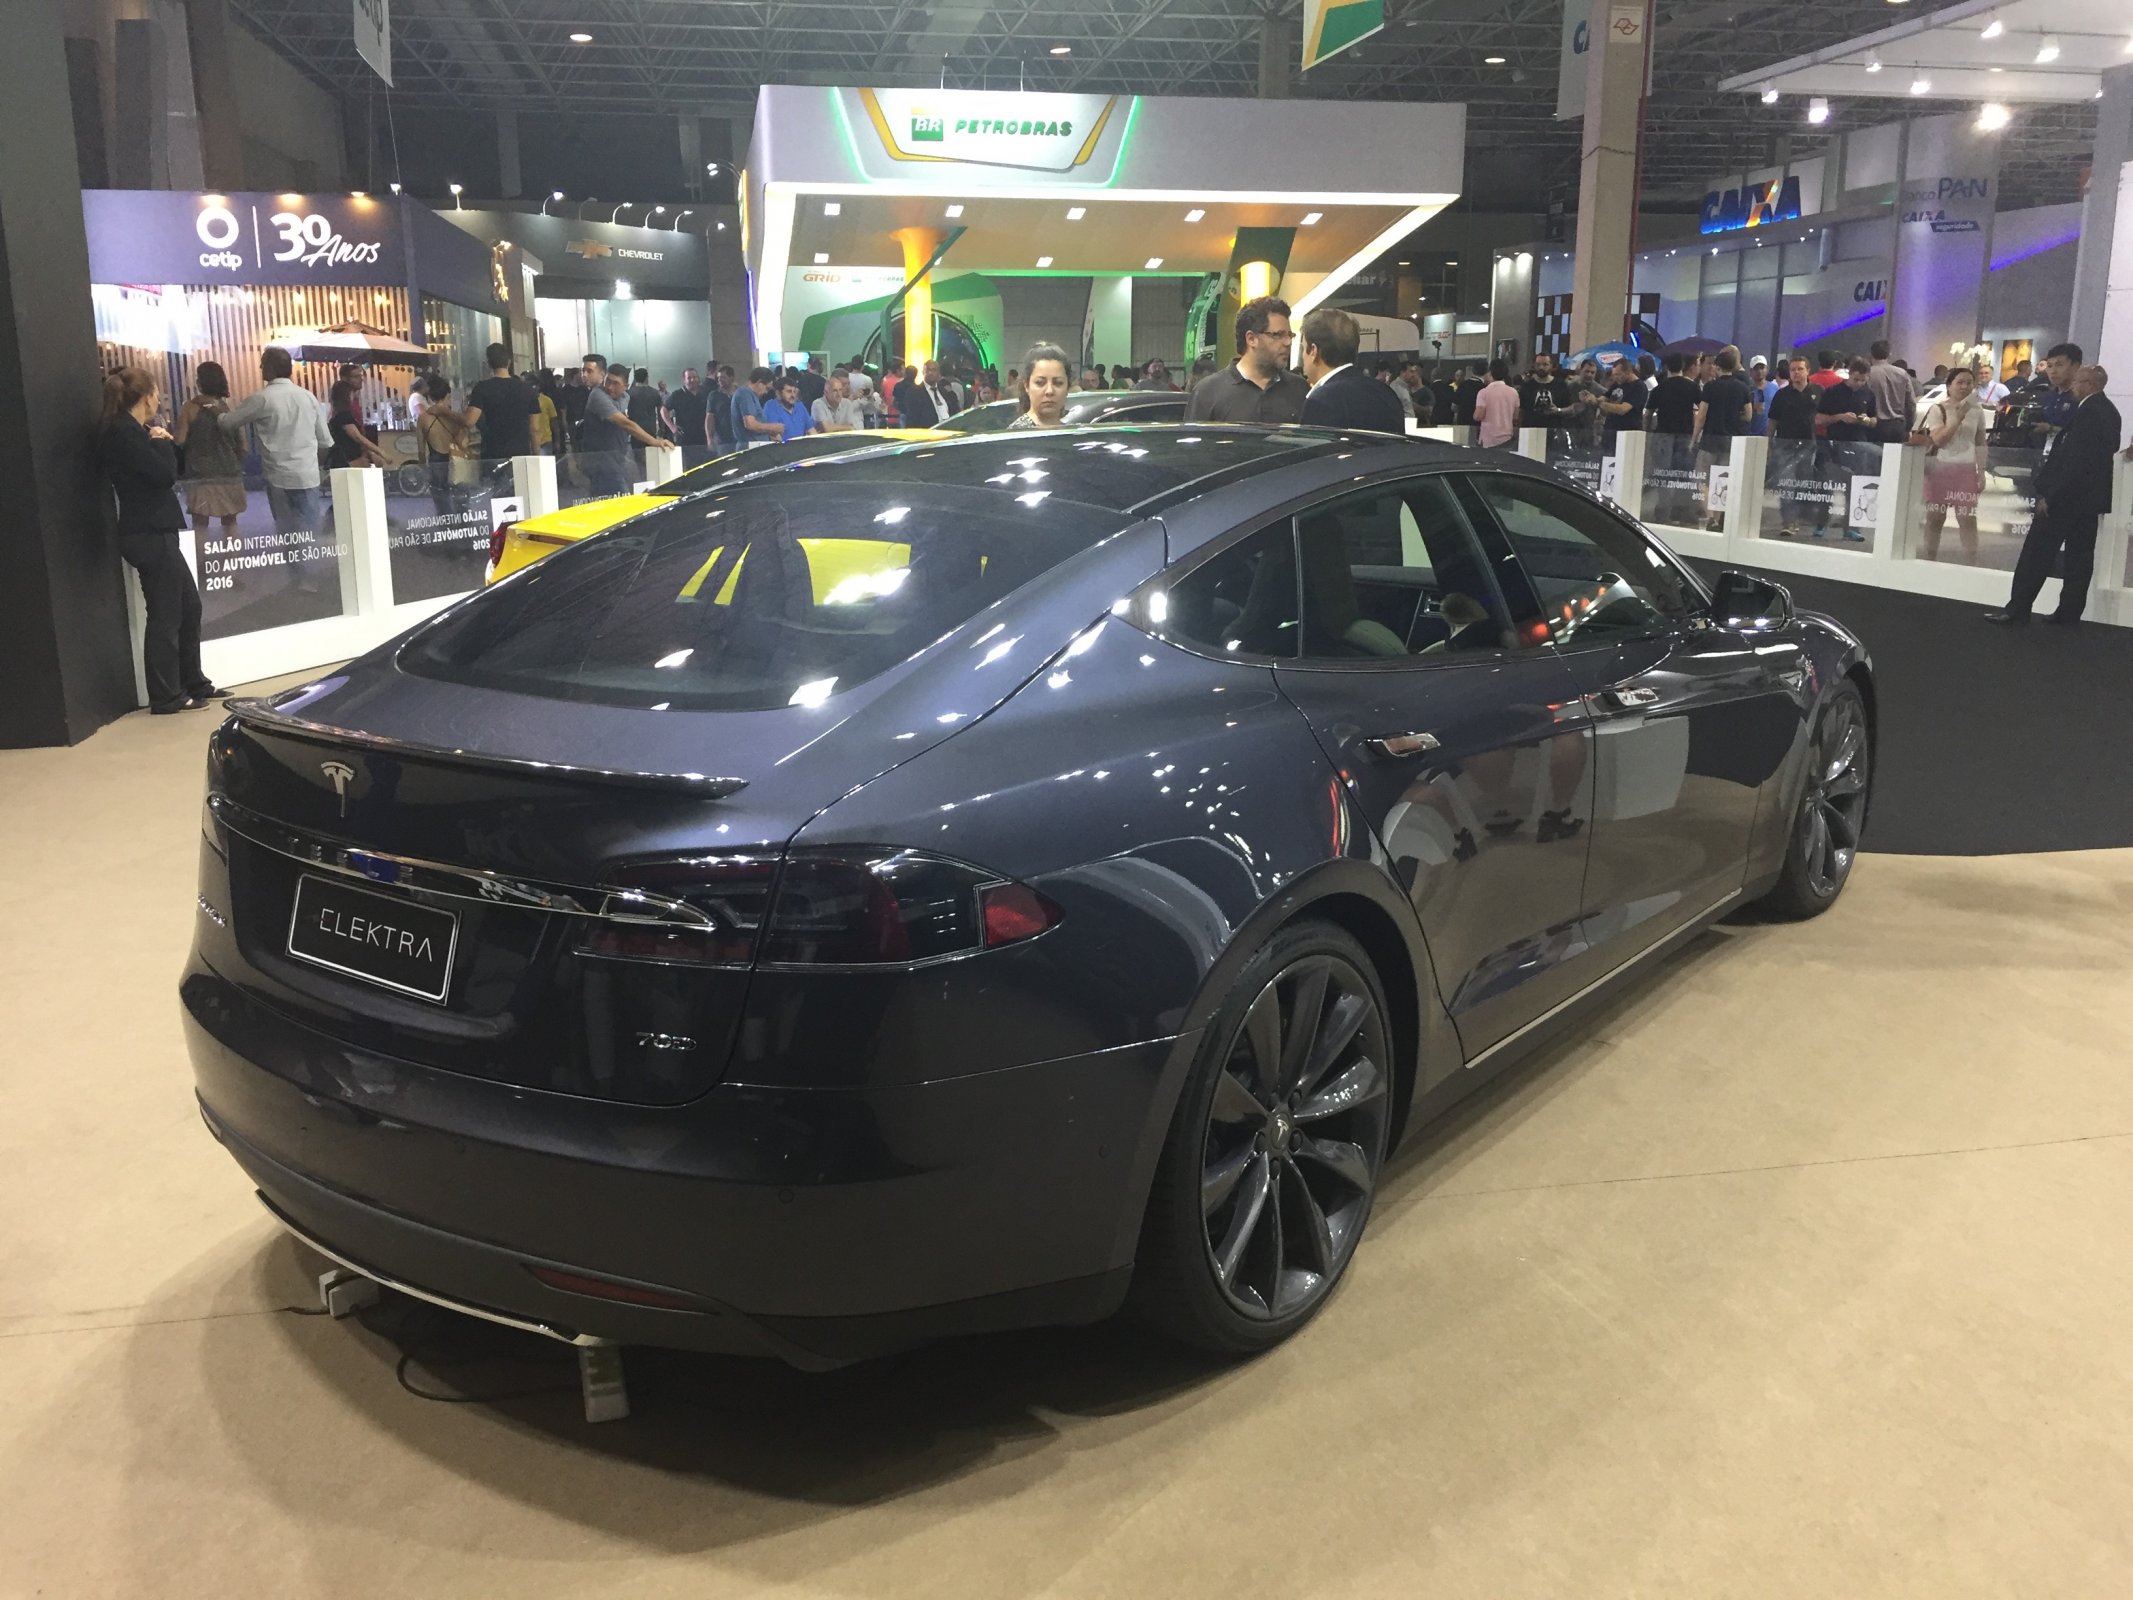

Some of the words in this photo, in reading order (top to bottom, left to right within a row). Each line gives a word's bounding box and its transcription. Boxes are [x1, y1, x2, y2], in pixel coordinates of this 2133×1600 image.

[914, 117, 942, 132] BR
[955, 118, 1073, 137] PETROBRAS
[1901, 189, 1936, 201] anco
[1938, 177, 1988, 200] PAN
[1700, 175, 1801, 235] CAIXA
[270, 212, 331, 262] 30
[301, 234, 381, 268] Anos
[200, 251, 242, 271] cetip
[618, 248, 664, 261] CHEVROLET
[1853, 280, 1887, 302] CAI
[204, 536, 242, 555] SALÃO
[244, 530, 316, 550] INTERNACIONAL
[205, 560, 220, 574] DO
[222, 551, 287, 572] AUTOMÓVEL
[288, 550, 300, 563] DE
[302, 546, 320, 561] SÃO
[321, 543, 348, 558] PAULO
[206, 575, 233, 591] 2016
[319, 907, 433, 963] ELEKTRA
